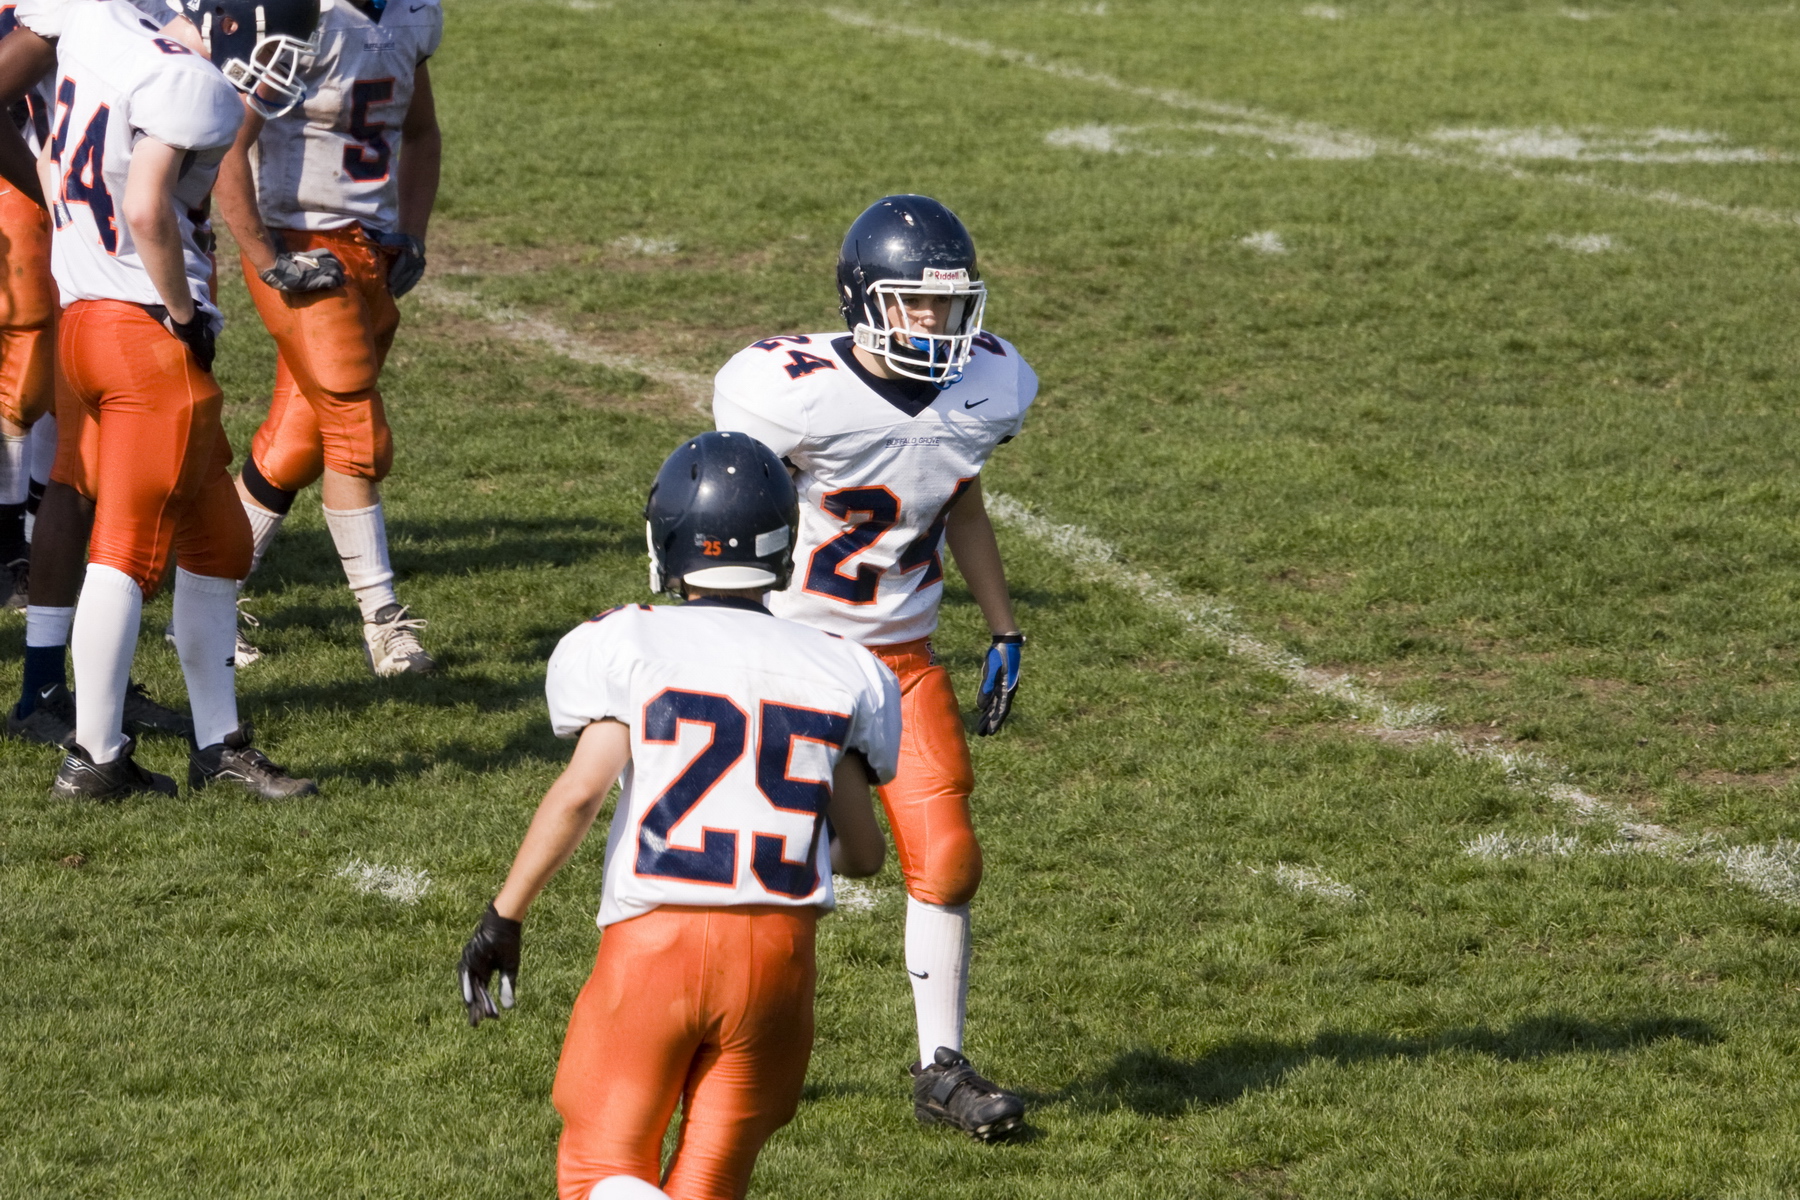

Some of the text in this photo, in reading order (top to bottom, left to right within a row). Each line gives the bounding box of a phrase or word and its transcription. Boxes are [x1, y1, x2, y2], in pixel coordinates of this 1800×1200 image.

[342, 77, 396, 183] 5
[934, 270, 959, 280] Riddell
[702, 540, 722, 557] 25
[634, 687, 853, 901] 25
